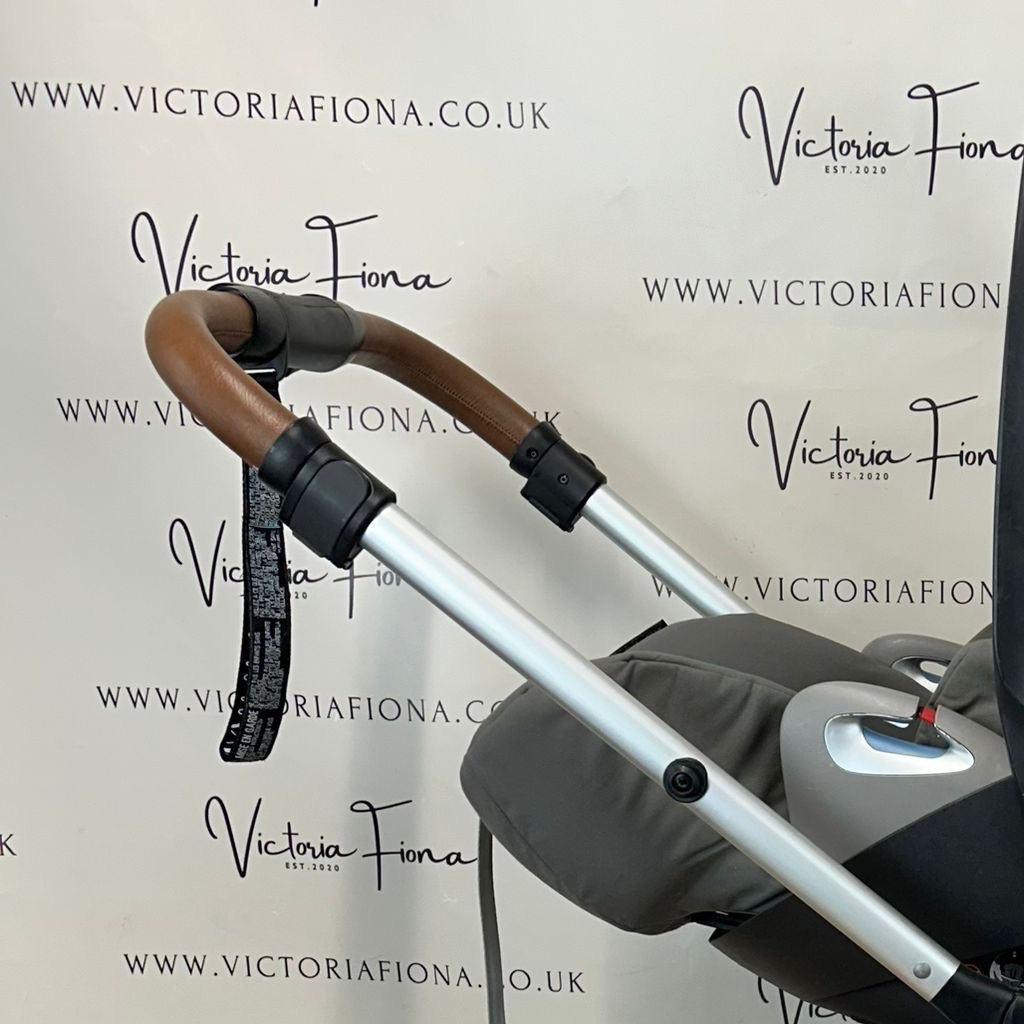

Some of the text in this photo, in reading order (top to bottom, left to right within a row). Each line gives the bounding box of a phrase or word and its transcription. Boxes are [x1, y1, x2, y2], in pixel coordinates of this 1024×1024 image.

[11, 81, 551, 130] WWW.VICTORIAFIONA.CO.UK
[738, 85, 910, 186] Victoria
[825, 165, 887, 174] EST.2020
[131, 211, 452, 300] Victoria Fiona
[747, 398, 912, 492] Victoria
[830, 471, 890, 481] EST.2020
[204, 795, 477, 891] Victoria Fiona
[284, 862, 340, 872] EST.2020
[123, 953, 587, 993] WWW.VICTORIAFIONA.O.UK
